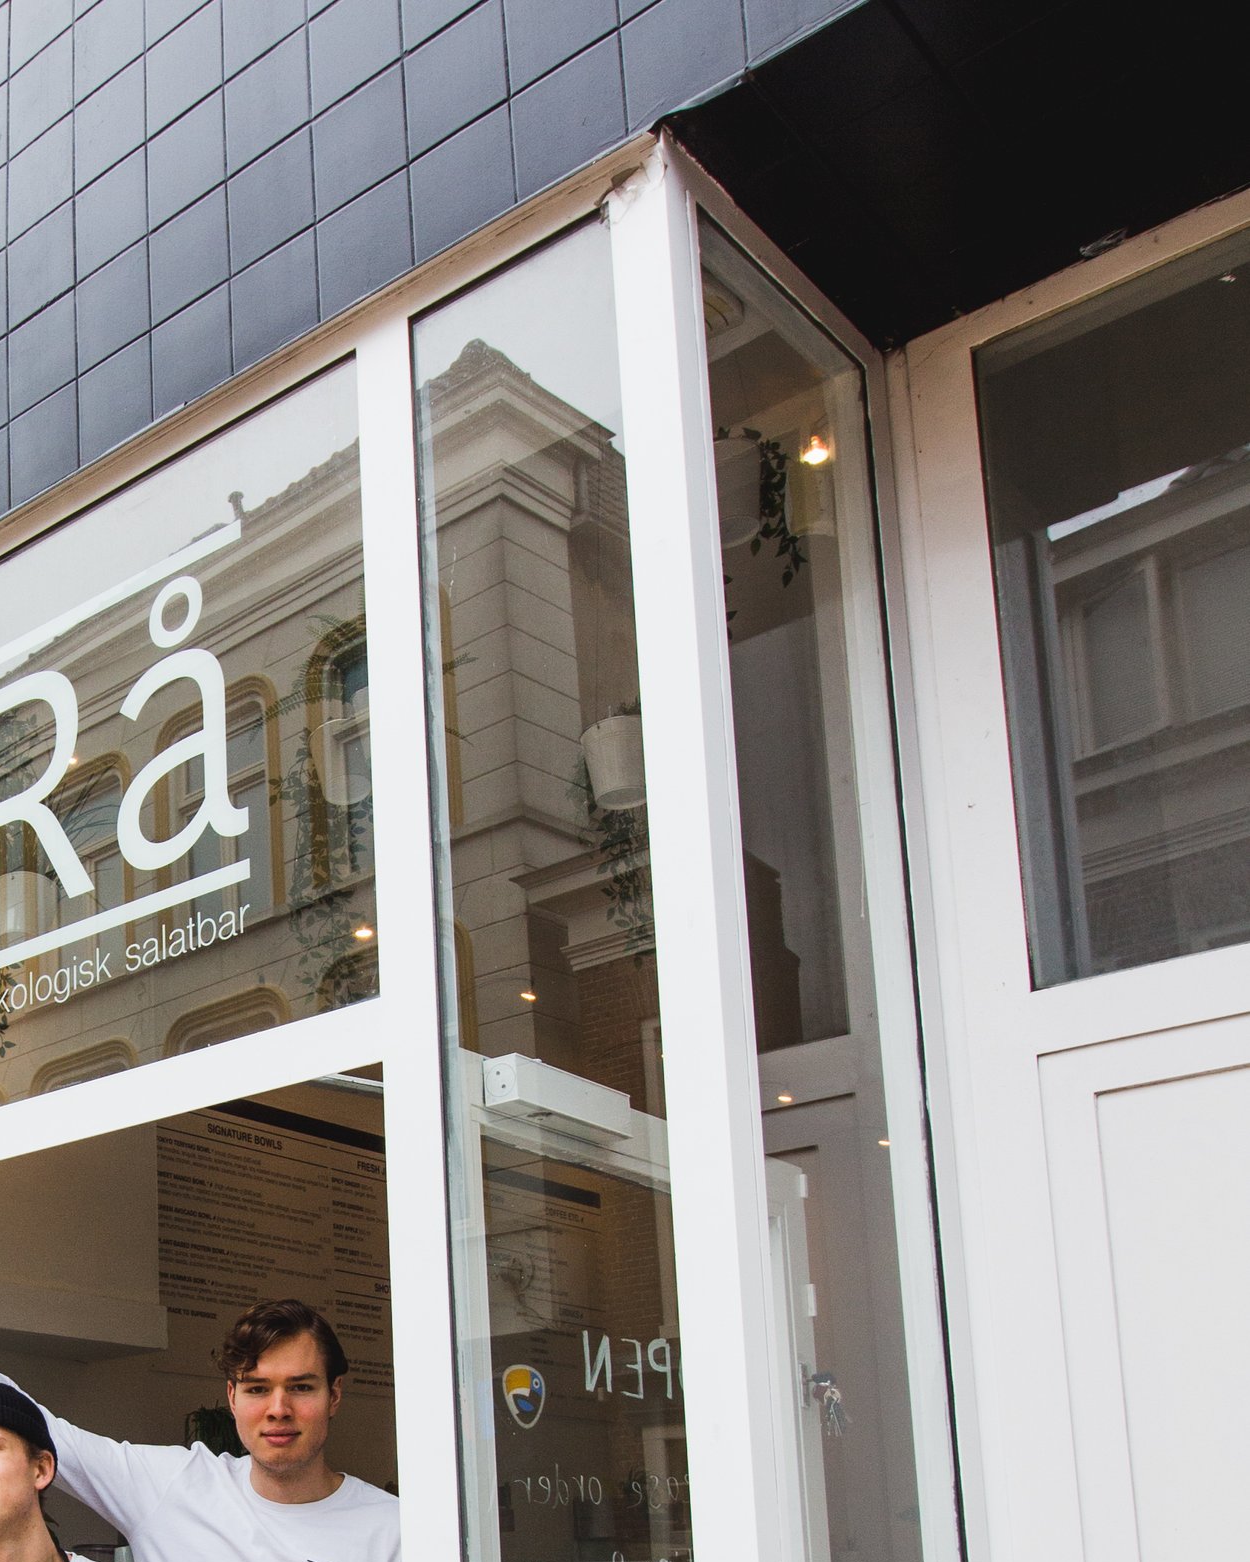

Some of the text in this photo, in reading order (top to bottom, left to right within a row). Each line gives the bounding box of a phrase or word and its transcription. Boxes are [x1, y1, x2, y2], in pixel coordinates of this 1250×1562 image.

[124, 902, 250, 973] salatbar
[207, 1123, 283, 1151] SIGNATURE BOWLS
[357, 1161, 380, 1175] FRESH
[374, 1283, 390, 1294] SHO
